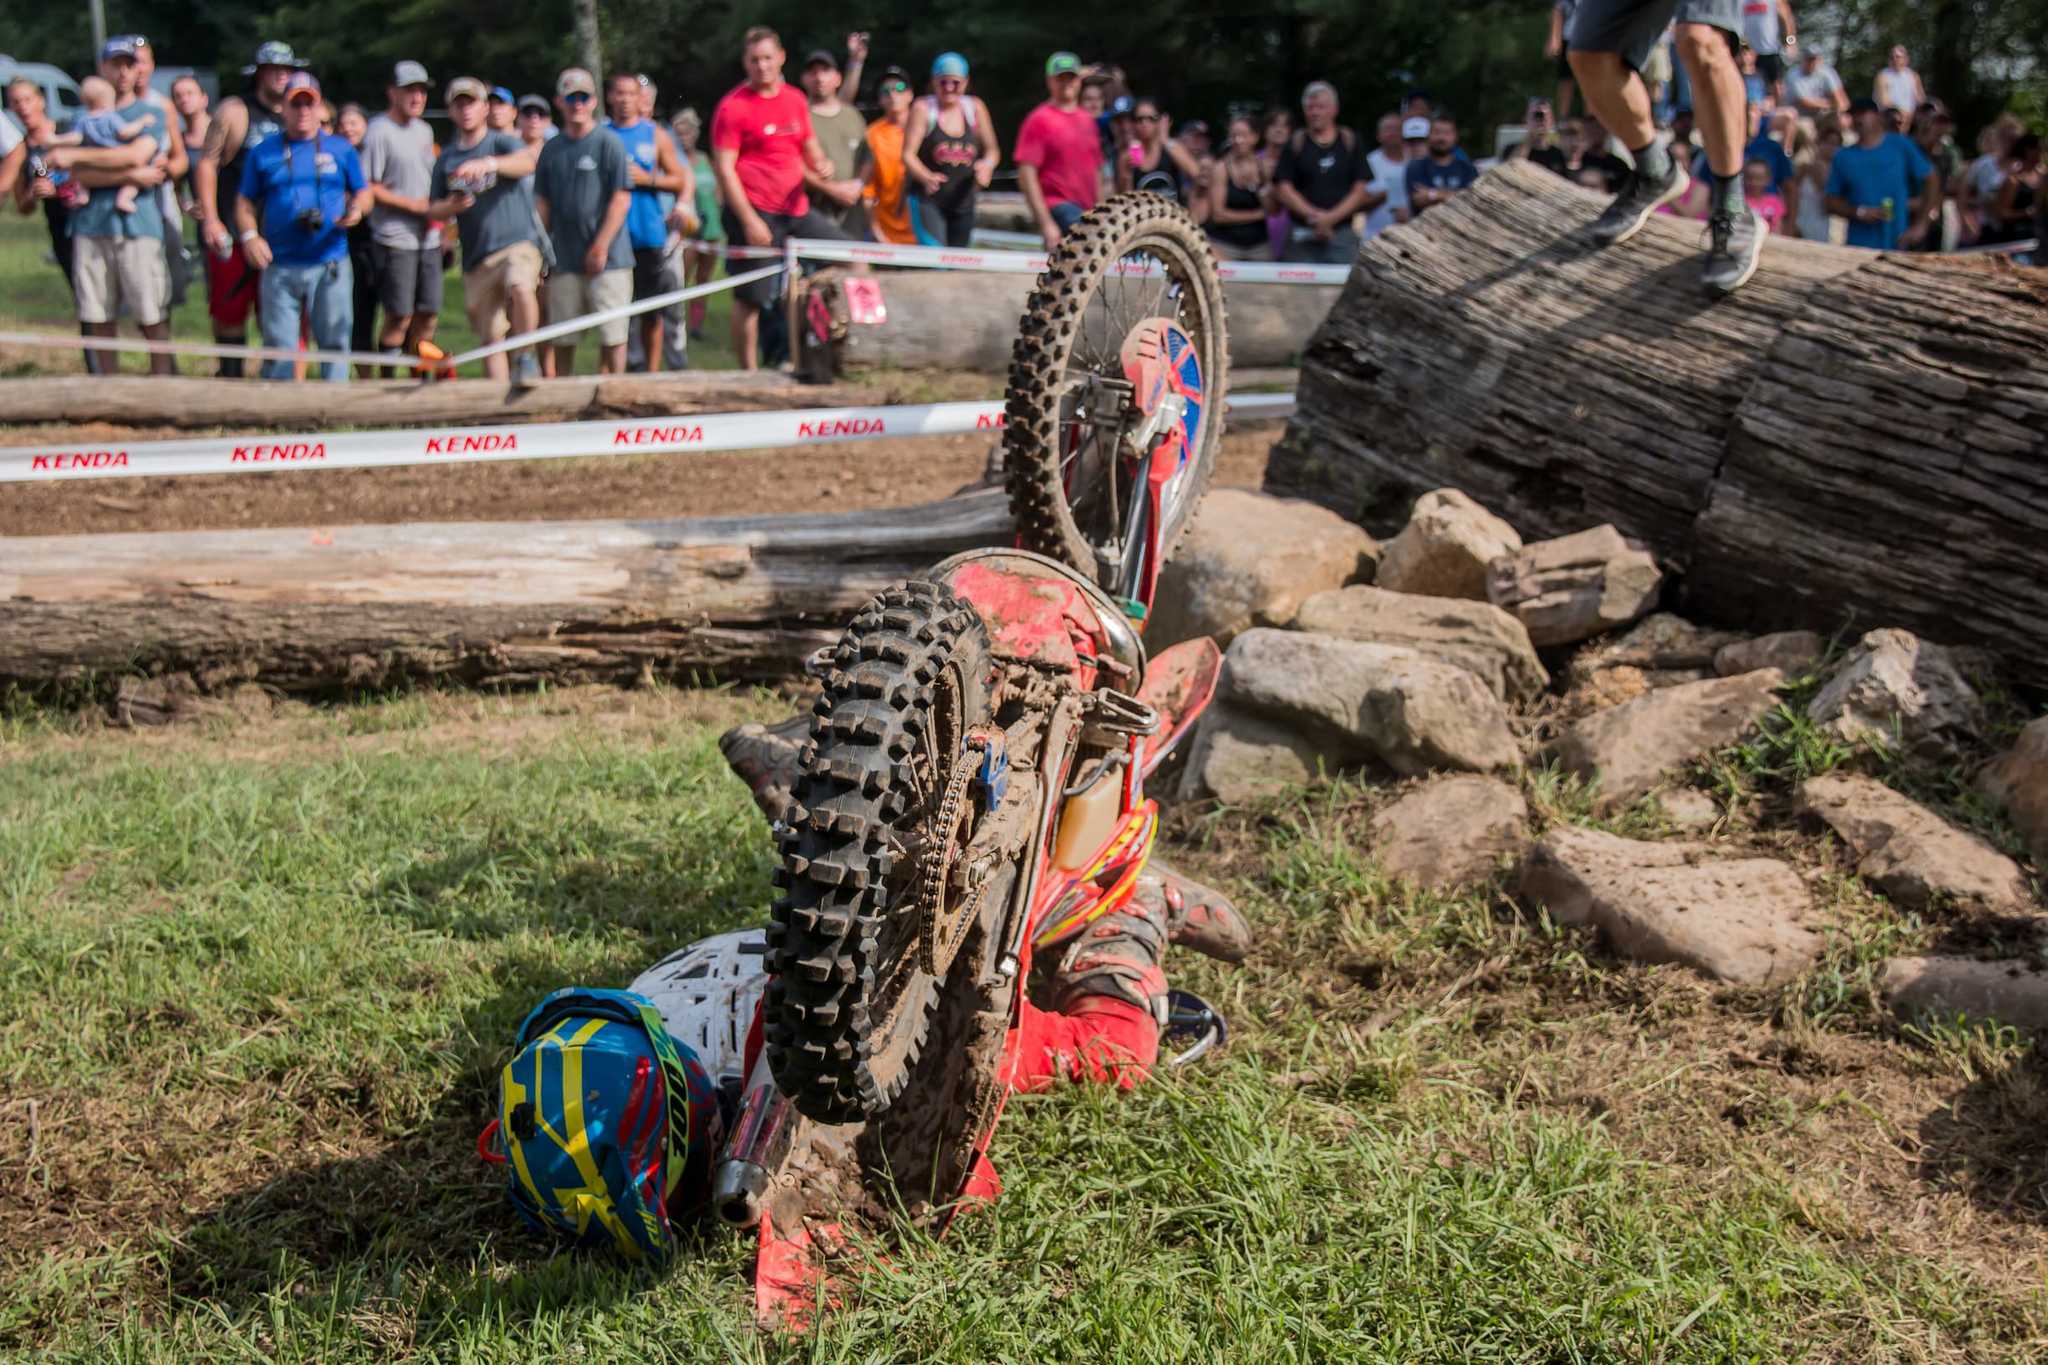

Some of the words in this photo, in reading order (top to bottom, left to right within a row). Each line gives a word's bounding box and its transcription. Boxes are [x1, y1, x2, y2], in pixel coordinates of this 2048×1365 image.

[612, 425, 704, 445] KENDA
[797, 418, 885, 438] KENDA
[230, 442, 327, 463] KENDA
[425, 433, 518, 455] KENDA
[31, 451, 129, 471] KENDA
